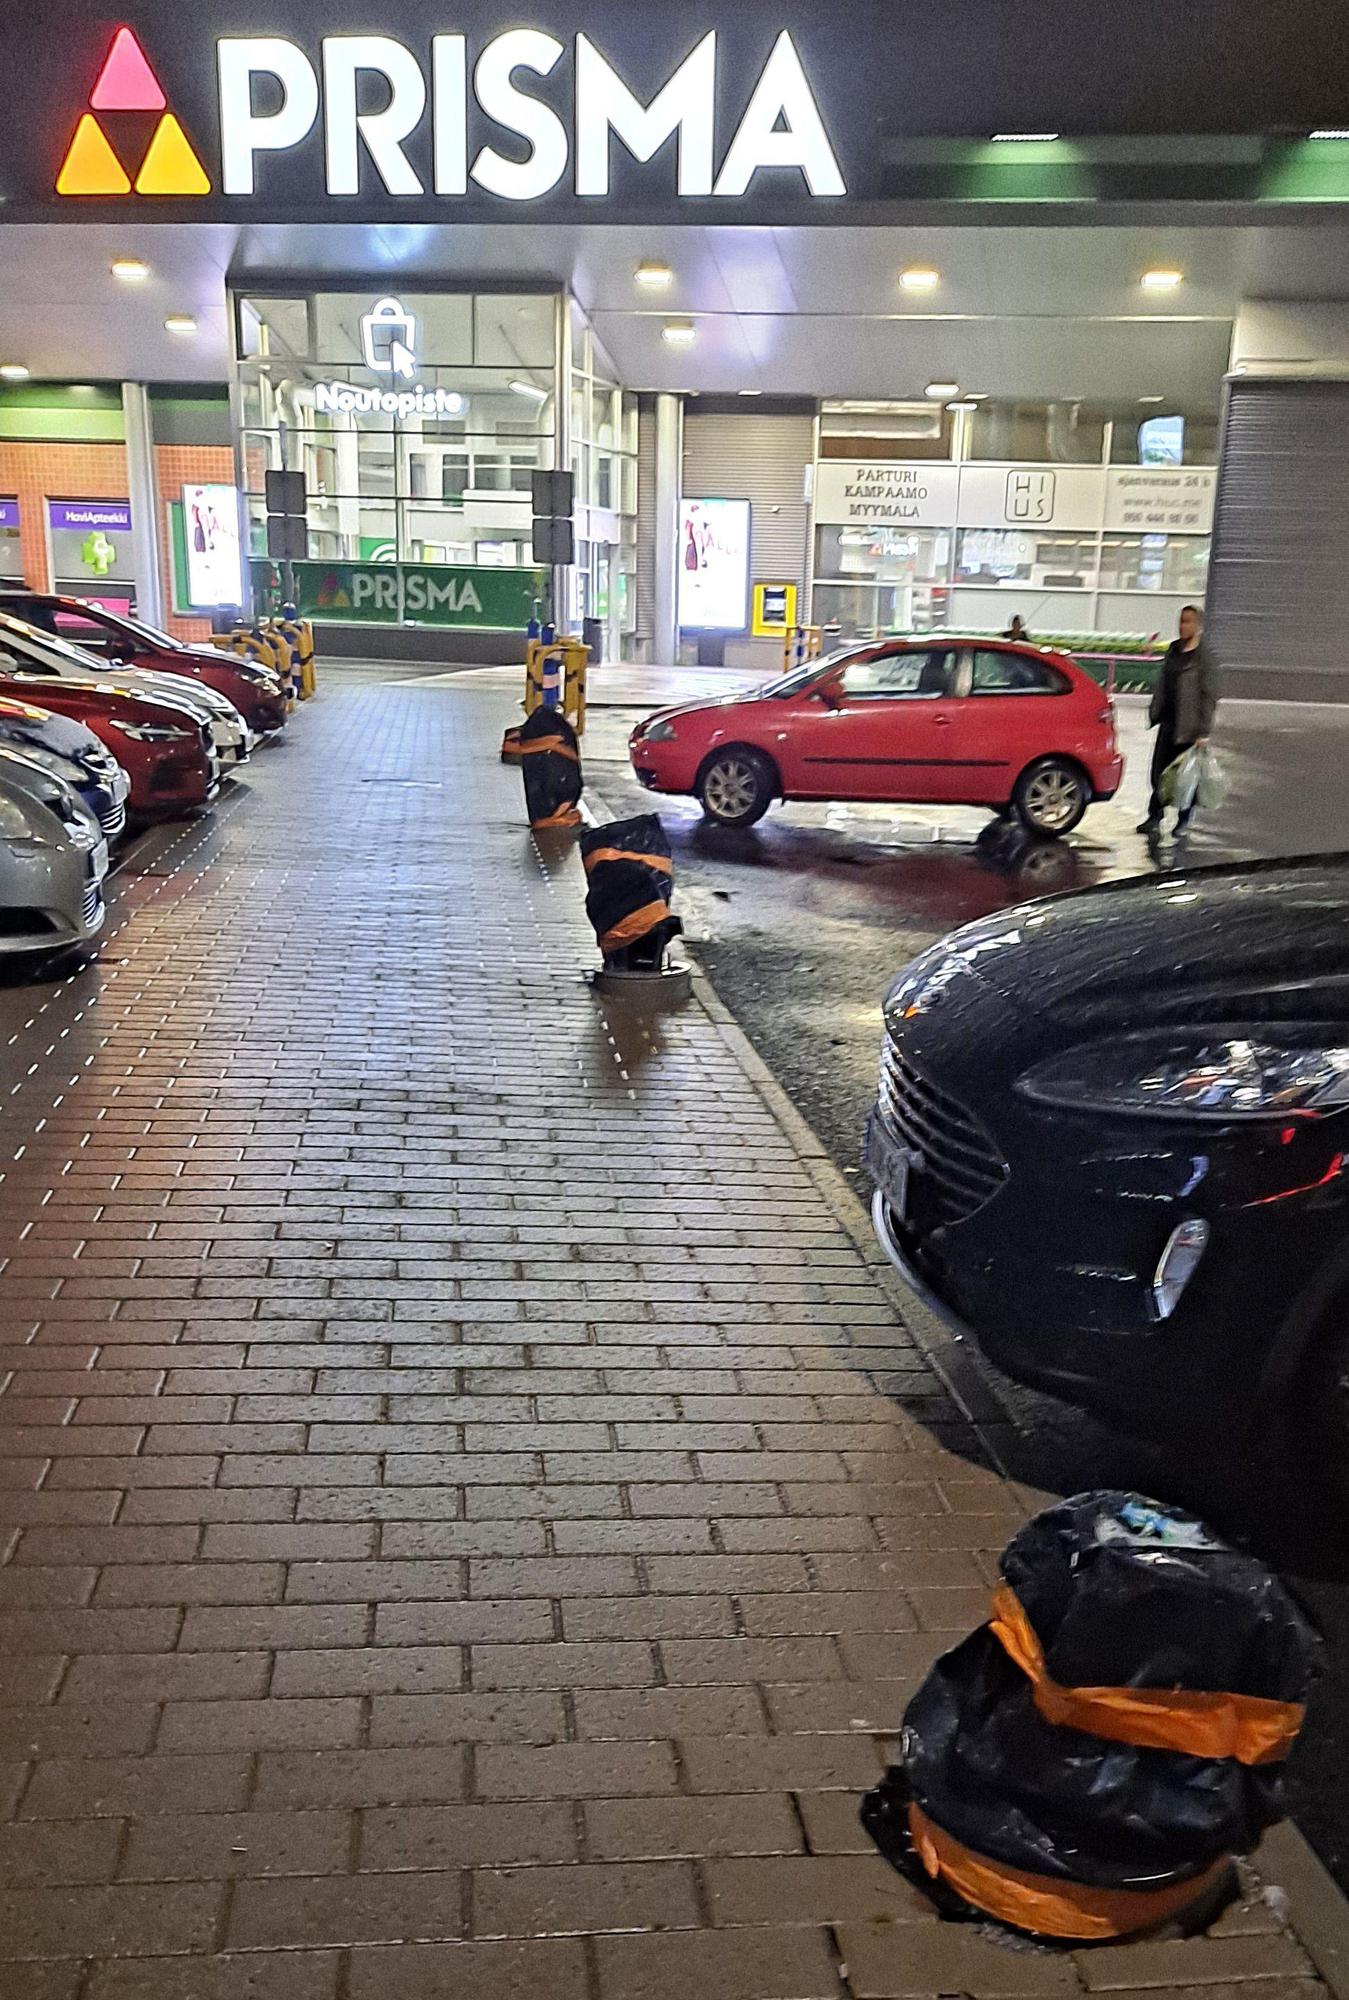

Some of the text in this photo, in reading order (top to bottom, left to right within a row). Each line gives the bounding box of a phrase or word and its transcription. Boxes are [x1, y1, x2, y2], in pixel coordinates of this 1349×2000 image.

[217, 28, 847, 200] PRISMA
[314, 380, 462, 419] Noutopiste
[845, 485, 928, 499] KAMPAAMO
[857, 469, 917, 483] PARTURI
[352, 573, 483, 613] PRISMA
